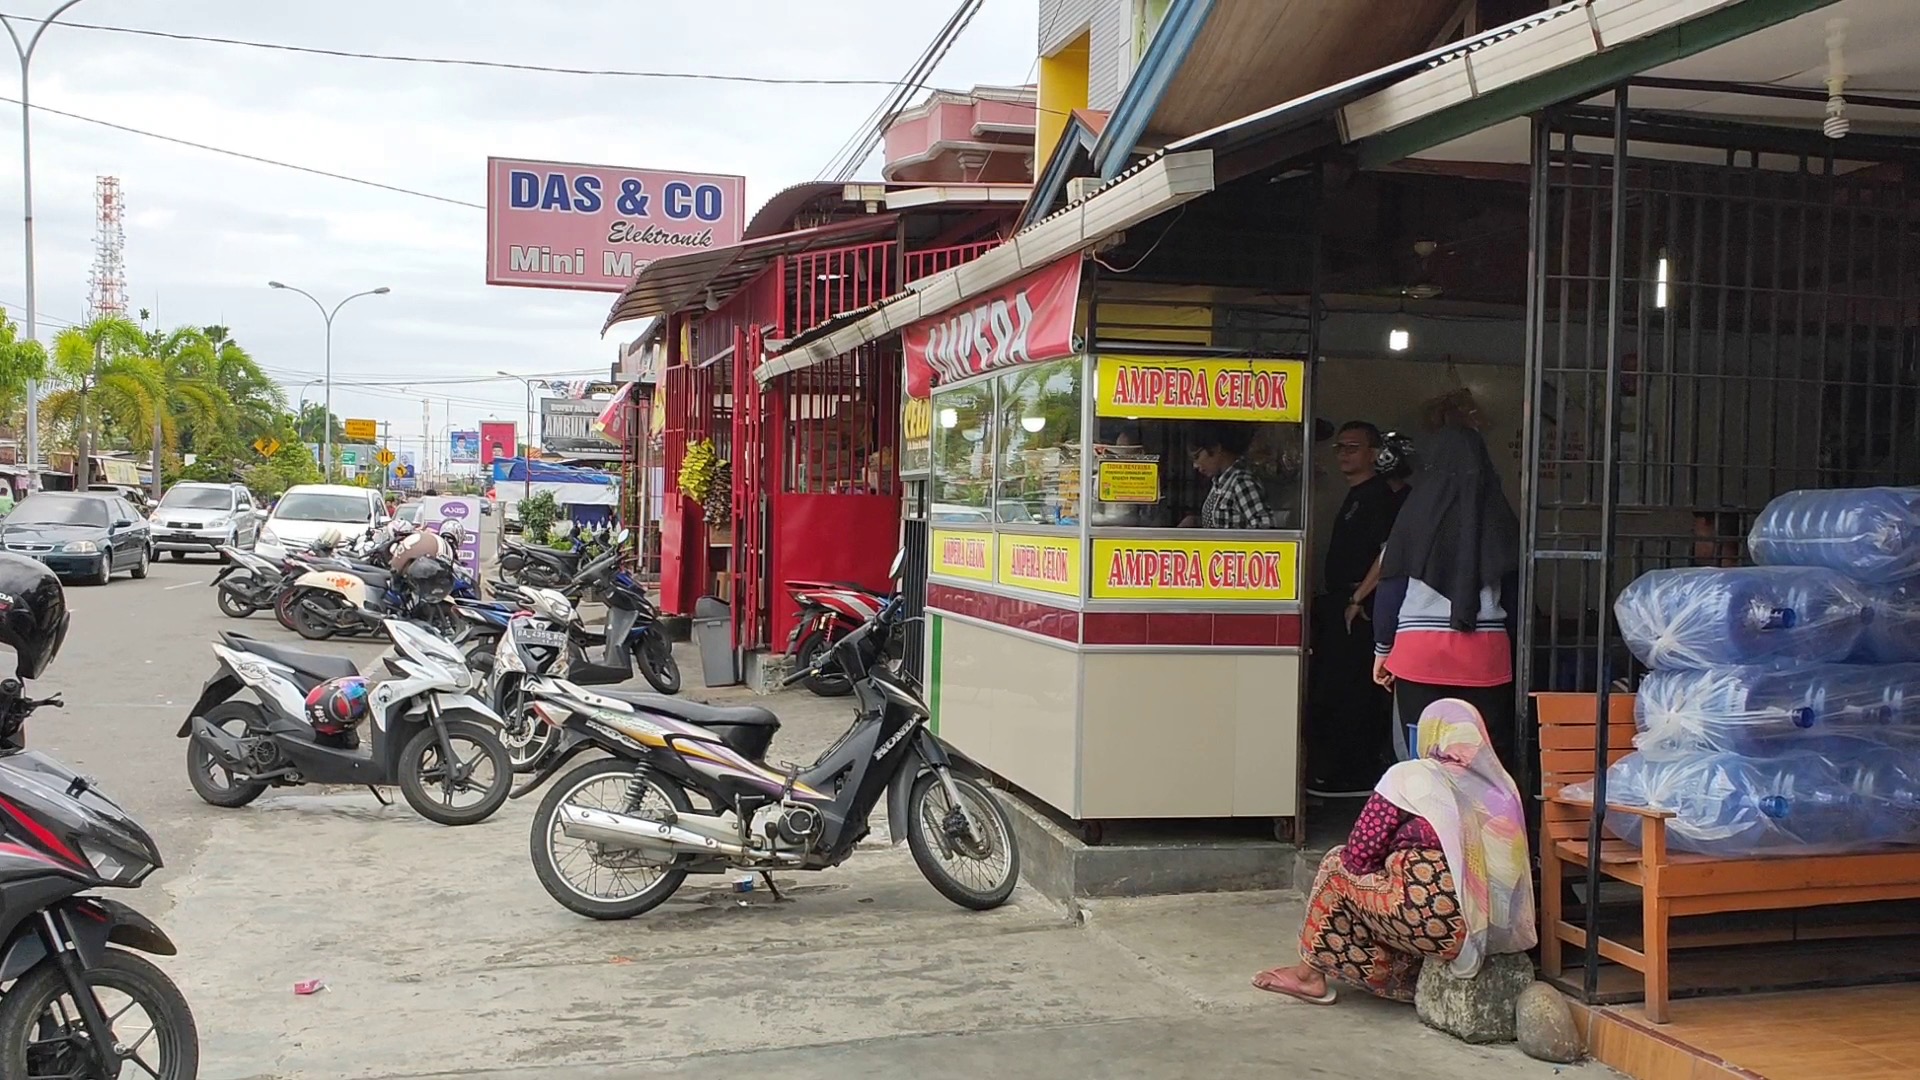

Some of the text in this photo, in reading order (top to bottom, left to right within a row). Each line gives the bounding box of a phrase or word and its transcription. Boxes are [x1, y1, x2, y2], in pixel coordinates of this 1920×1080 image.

[510, 170, 723, 221] DAS & CO
[607, 220, 713, 247] Elektronik
[510, 246, 585, 275] Mini
[925, 292, 1032, 386] AMPERA
[1113, 366, 1288, 411] AMPERA CELOK
[545, 414, 586, 438] AMBUN
[443, 506, 466, 514] AXIS
[943, 538, 985, 569] AMPERA CELOK
[1011, 544, 1068, 582] AMPERA CELOK
[1108, 549, 1281, 590] AMPERA CELOK
[873, 712, 921, 760] HONDA
